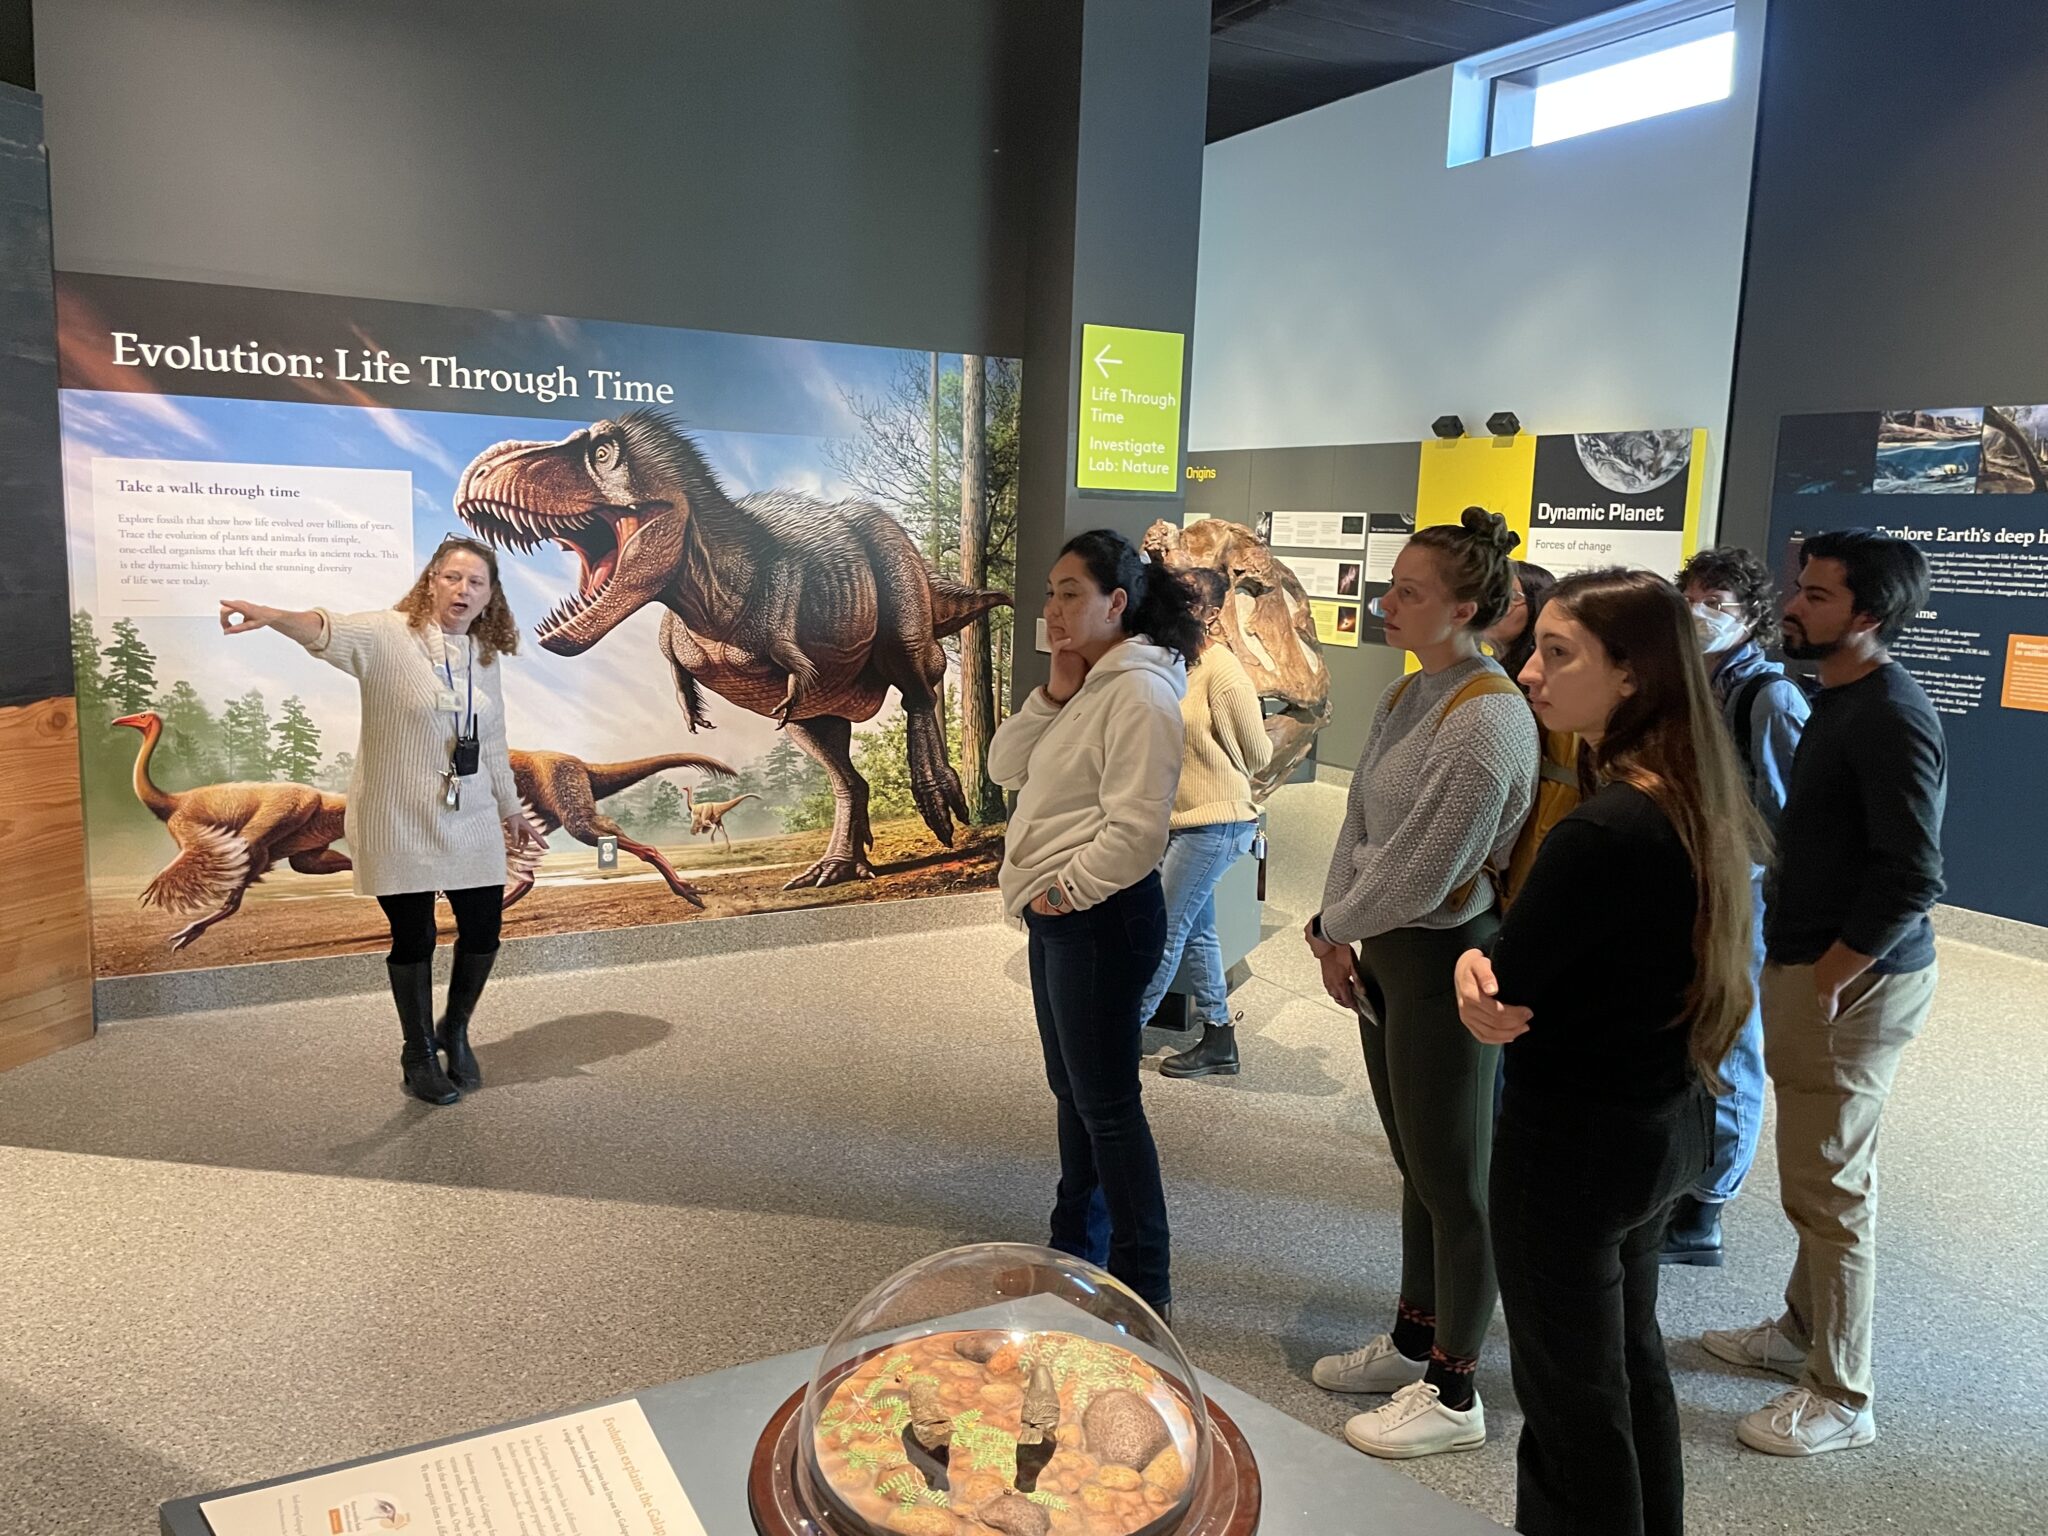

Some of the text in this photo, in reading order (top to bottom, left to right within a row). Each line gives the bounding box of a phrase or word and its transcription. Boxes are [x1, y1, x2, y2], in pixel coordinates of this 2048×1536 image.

[111, 331, 675, 405] Evolution: Life Through Time
[1091, 386, 1176, 410] Life Through
[1090, 408, 1124, 424] Time
[1090, 436, 1165, 457] Investigate
[1090, 457, 1170, 475] Lab: Nature
[1186, 466, 1217, 482] Origins
[117, 479, 301, 500] Take a walk through time
[1537, 502, 1664, 524] Dynamic Planet
[118, 514, 395, 532] Explore fossils that show how life evolved over billions of years.
[118, 529, 361, 546] Trace the evolution of plants and animals from simple,
[1535, 539, 1612, 553] Forces of change
[1936, 527, 1991, 542] Earth's
[1994, 527, 2035, 547] deep
[119, 545, 399, 559] one-celled organisms that left their marks in ancient rocks. This
[120, 560, 353, 574] is the dynamic history behind the stunning diversity
[121, 575, 131, 585] of
[133, 575, 149, 585] life
[182, 576, 210, 587] today.
[603, 1418, 626, 1455] Evolution
[622, 1456, 644, 1491] explains
[639, 1493, 652, 1508] the
